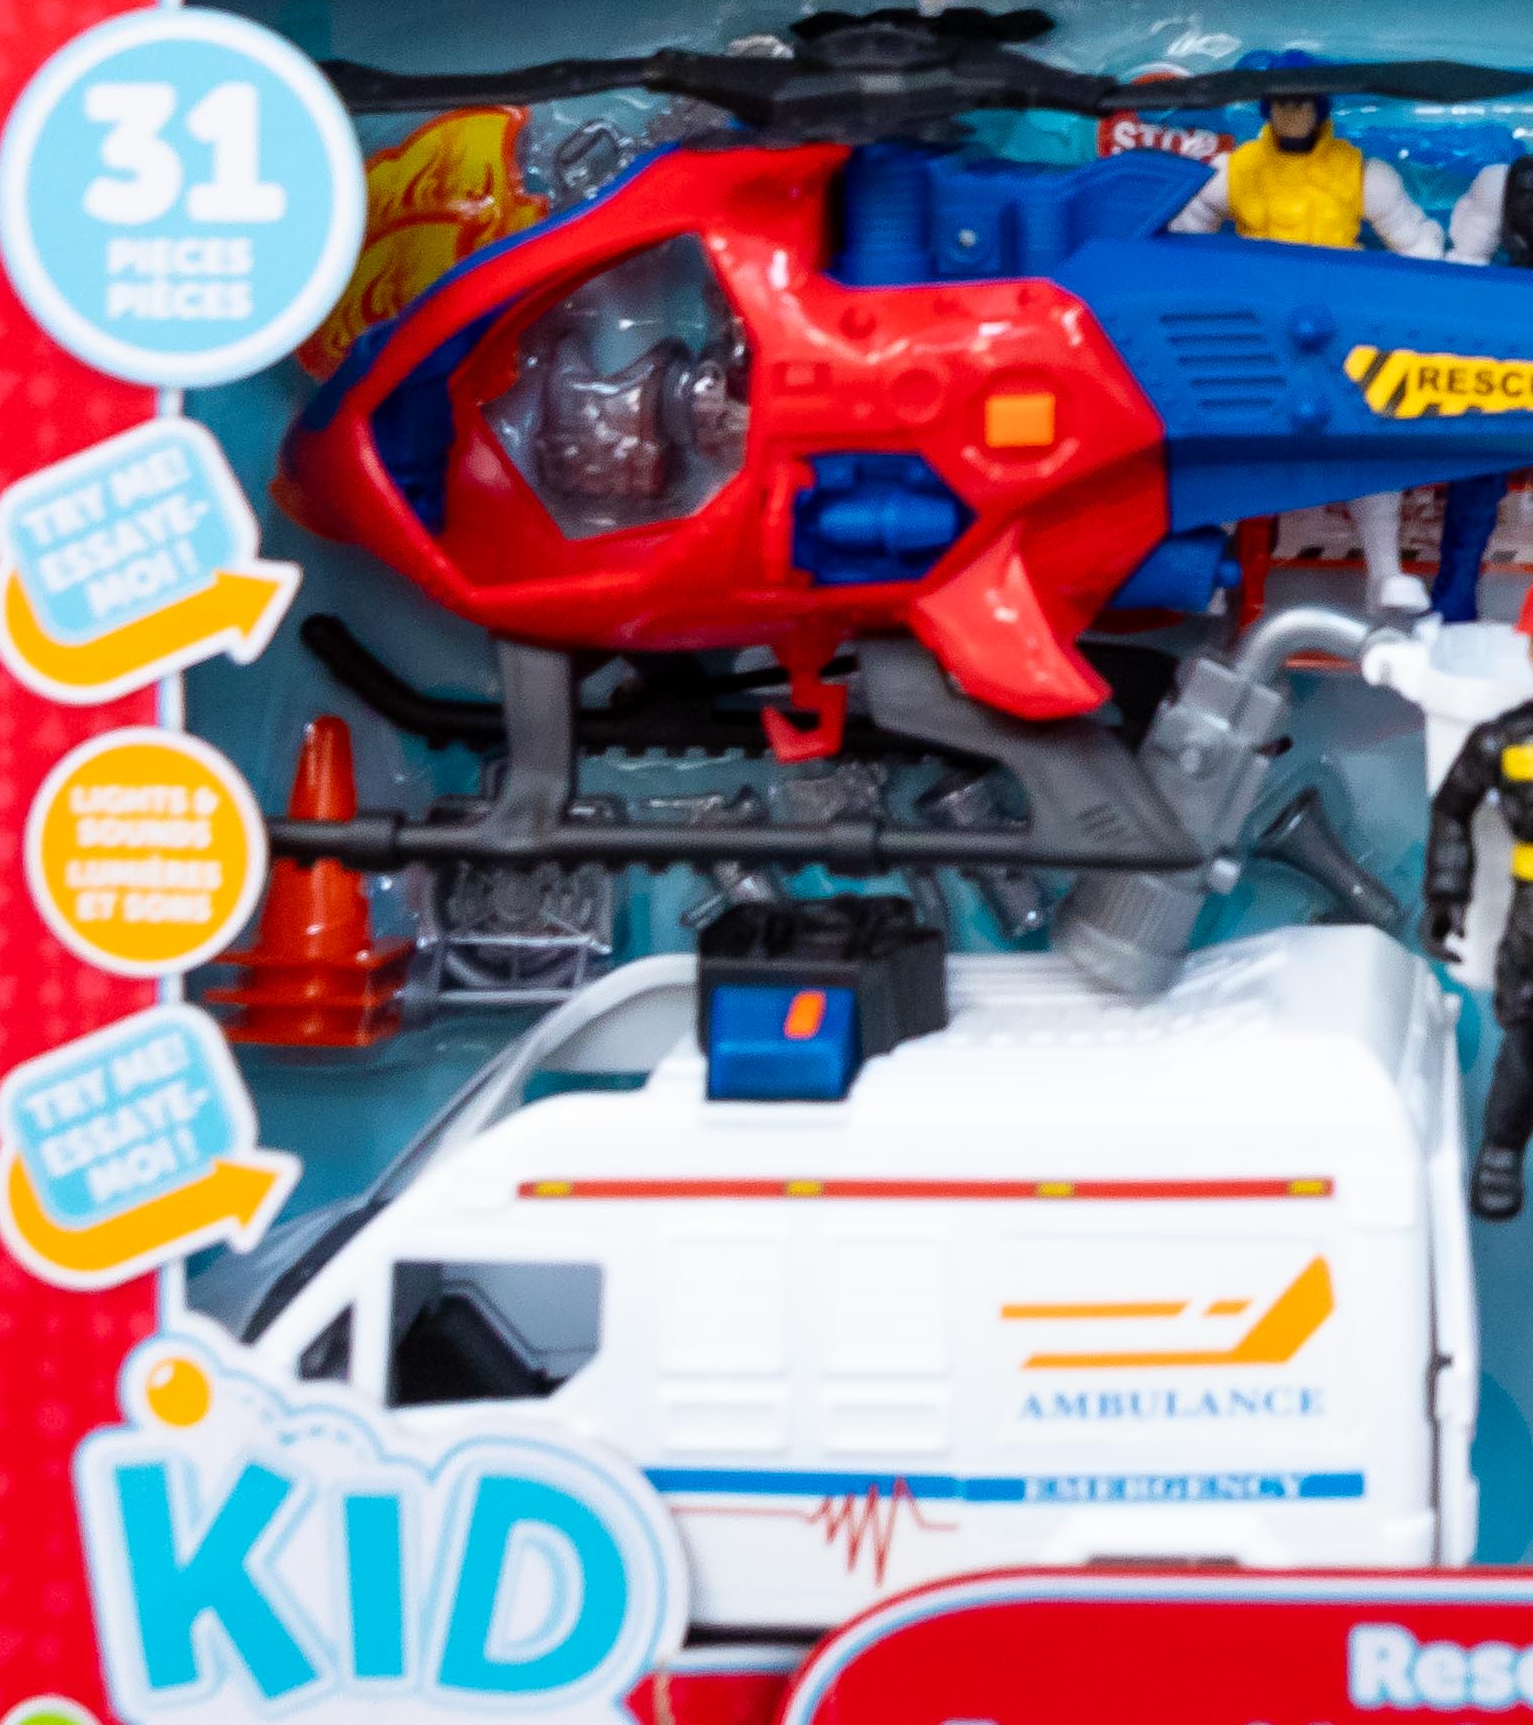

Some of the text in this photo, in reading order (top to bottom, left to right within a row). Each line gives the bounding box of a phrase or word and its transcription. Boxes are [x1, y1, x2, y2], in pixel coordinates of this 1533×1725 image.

[81, 82, 288, 225] 31
[106, 238, 254, 275] PIECES
[21, 447, 190, 542] TRY ME!
[37, 497, 210, 594] ESSAYE-
[71, 784, 218, 816] LIGHTS &
[76, 819, 213, 849] SOUNDS
[76, 892, 213, 924] ET SONS
[23, 1070, 109, 1133] TRY
[40, 1084, 213, 1181] ESSAYE-
[1018, 1385, 1326, 1422] AMBULANCE
[1024, 1473, 1305, 1502] EMERGENCY
[113, 1460, 631, 1702] KID
